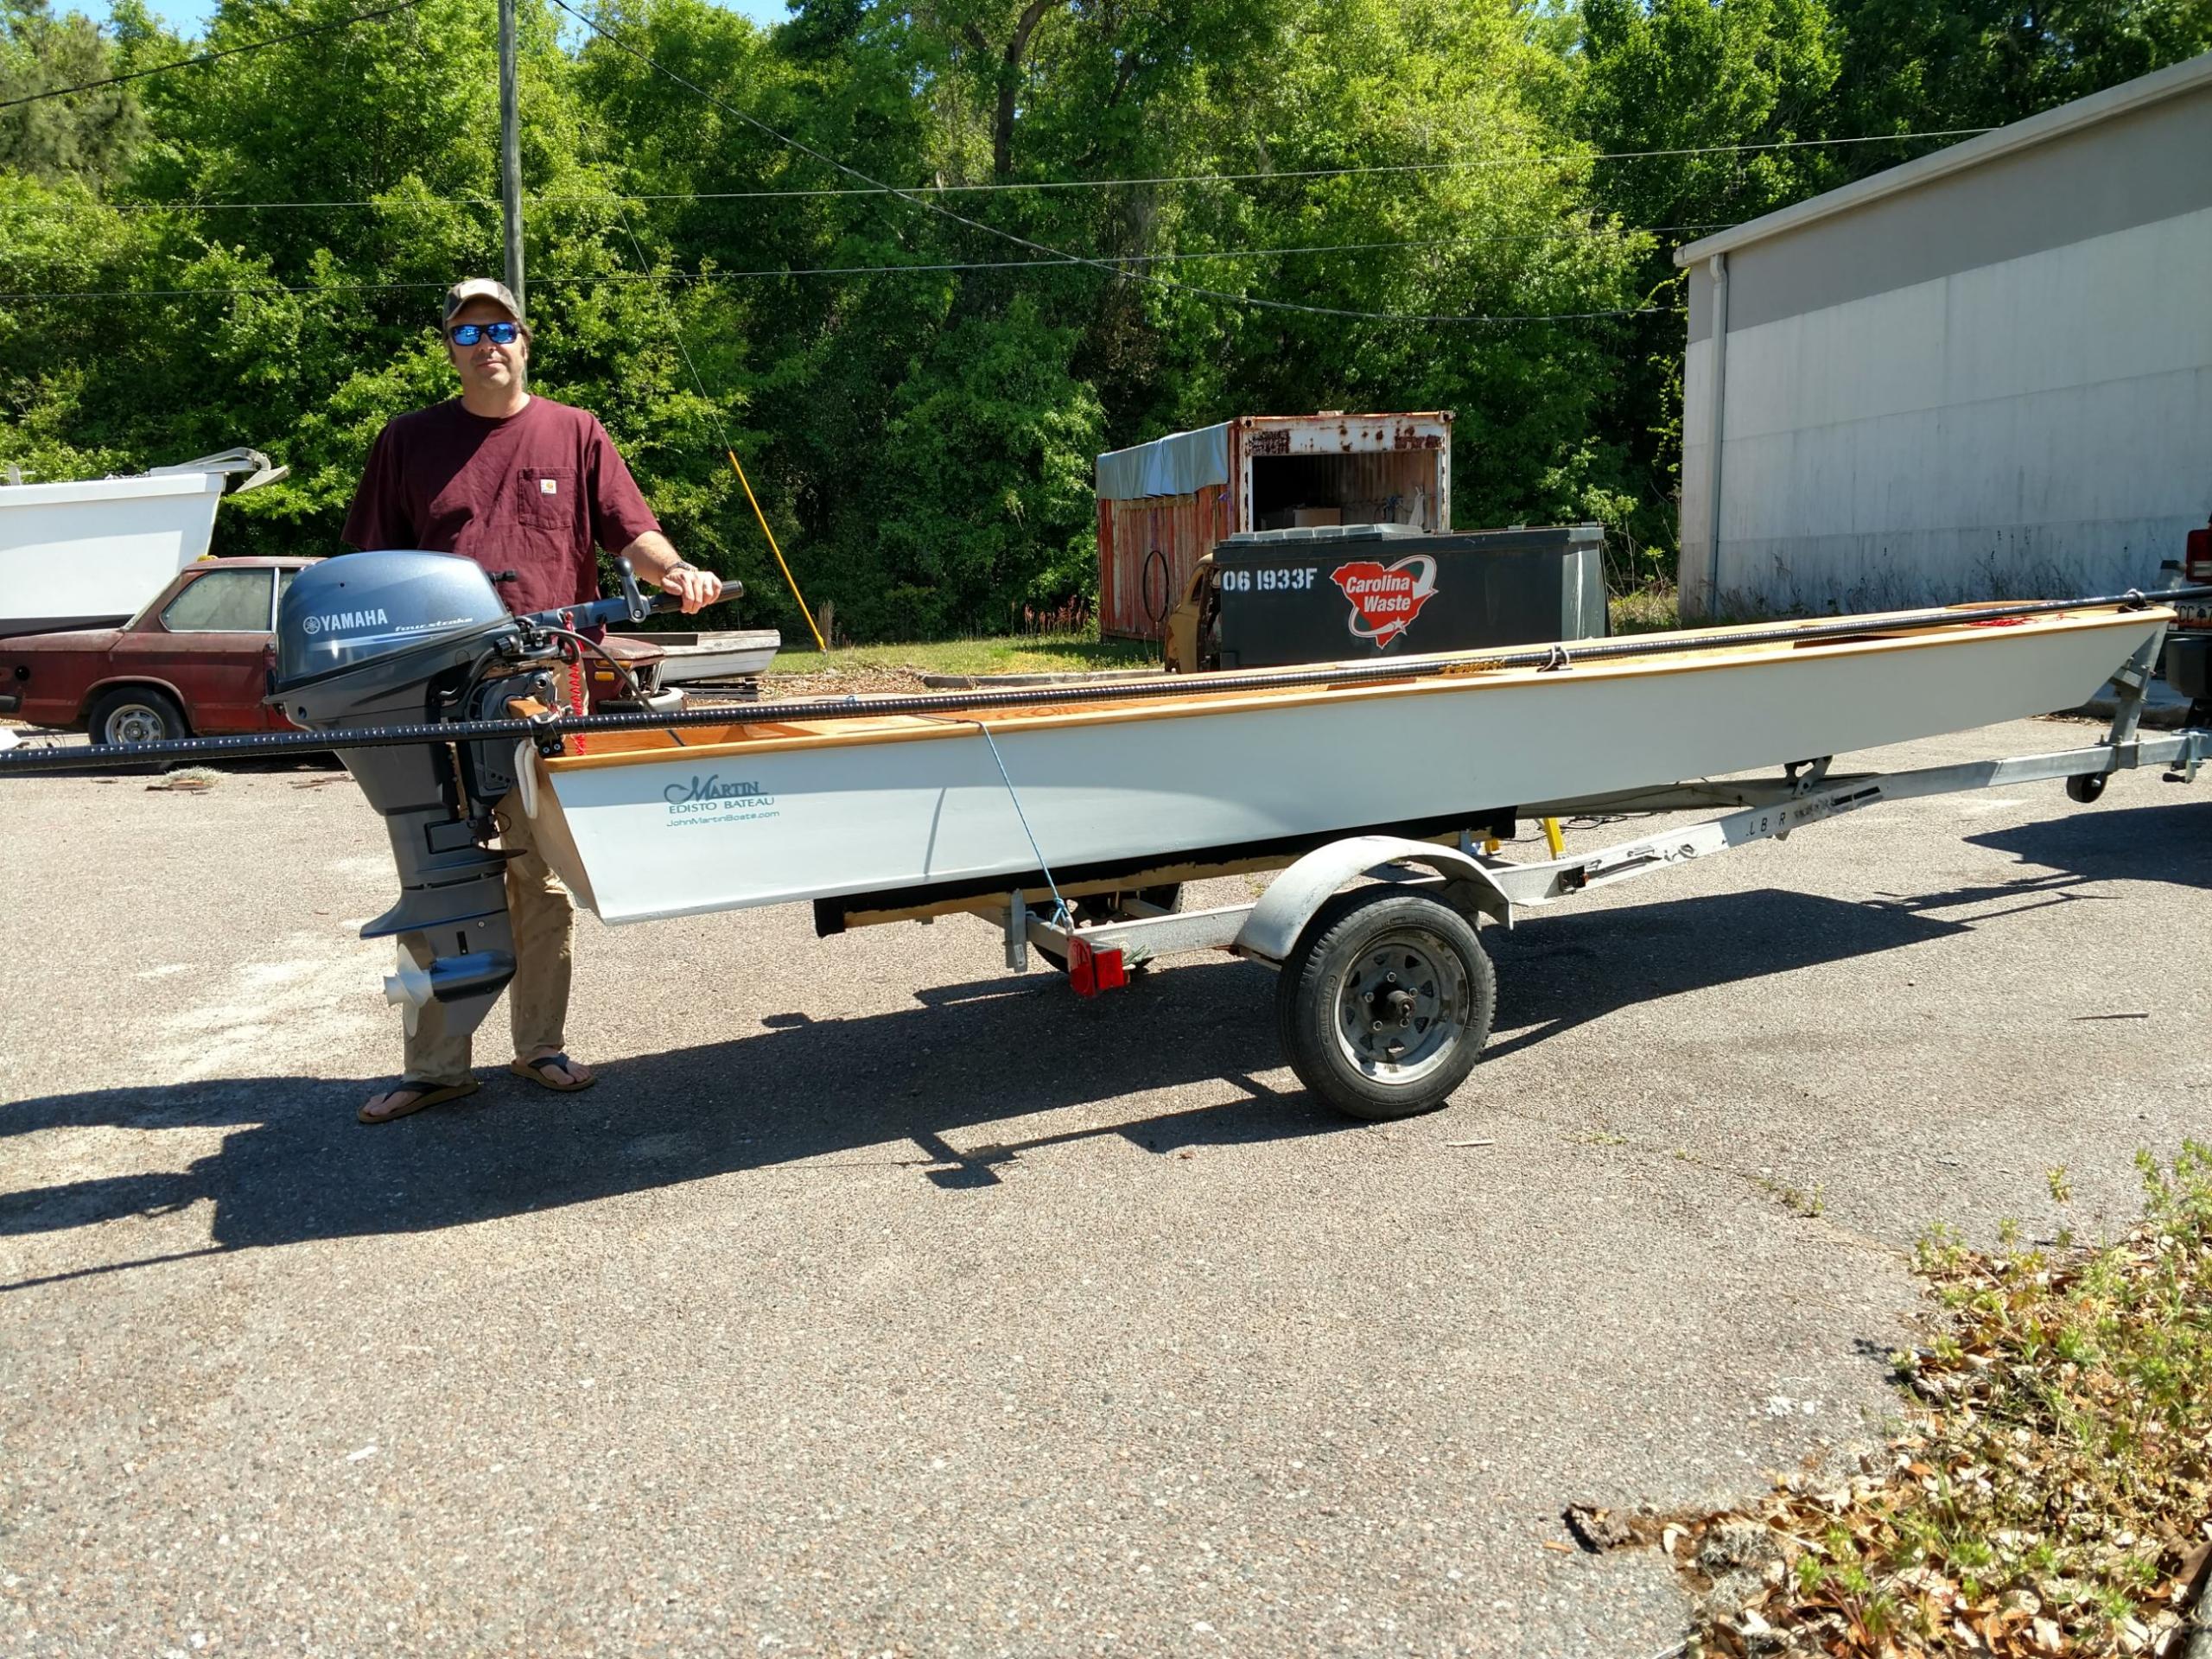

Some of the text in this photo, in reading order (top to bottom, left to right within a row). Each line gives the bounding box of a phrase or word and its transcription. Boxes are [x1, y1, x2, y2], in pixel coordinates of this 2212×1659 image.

[1223, 570, 1250, 592] 06
[1345, 575, 1411, 594] Carolina
[1363, 596, 1411, 613] Waste
[320, 608, 388, 632] YAMAHA
[669, 797, 775, 815] EDISTO BATEAU
